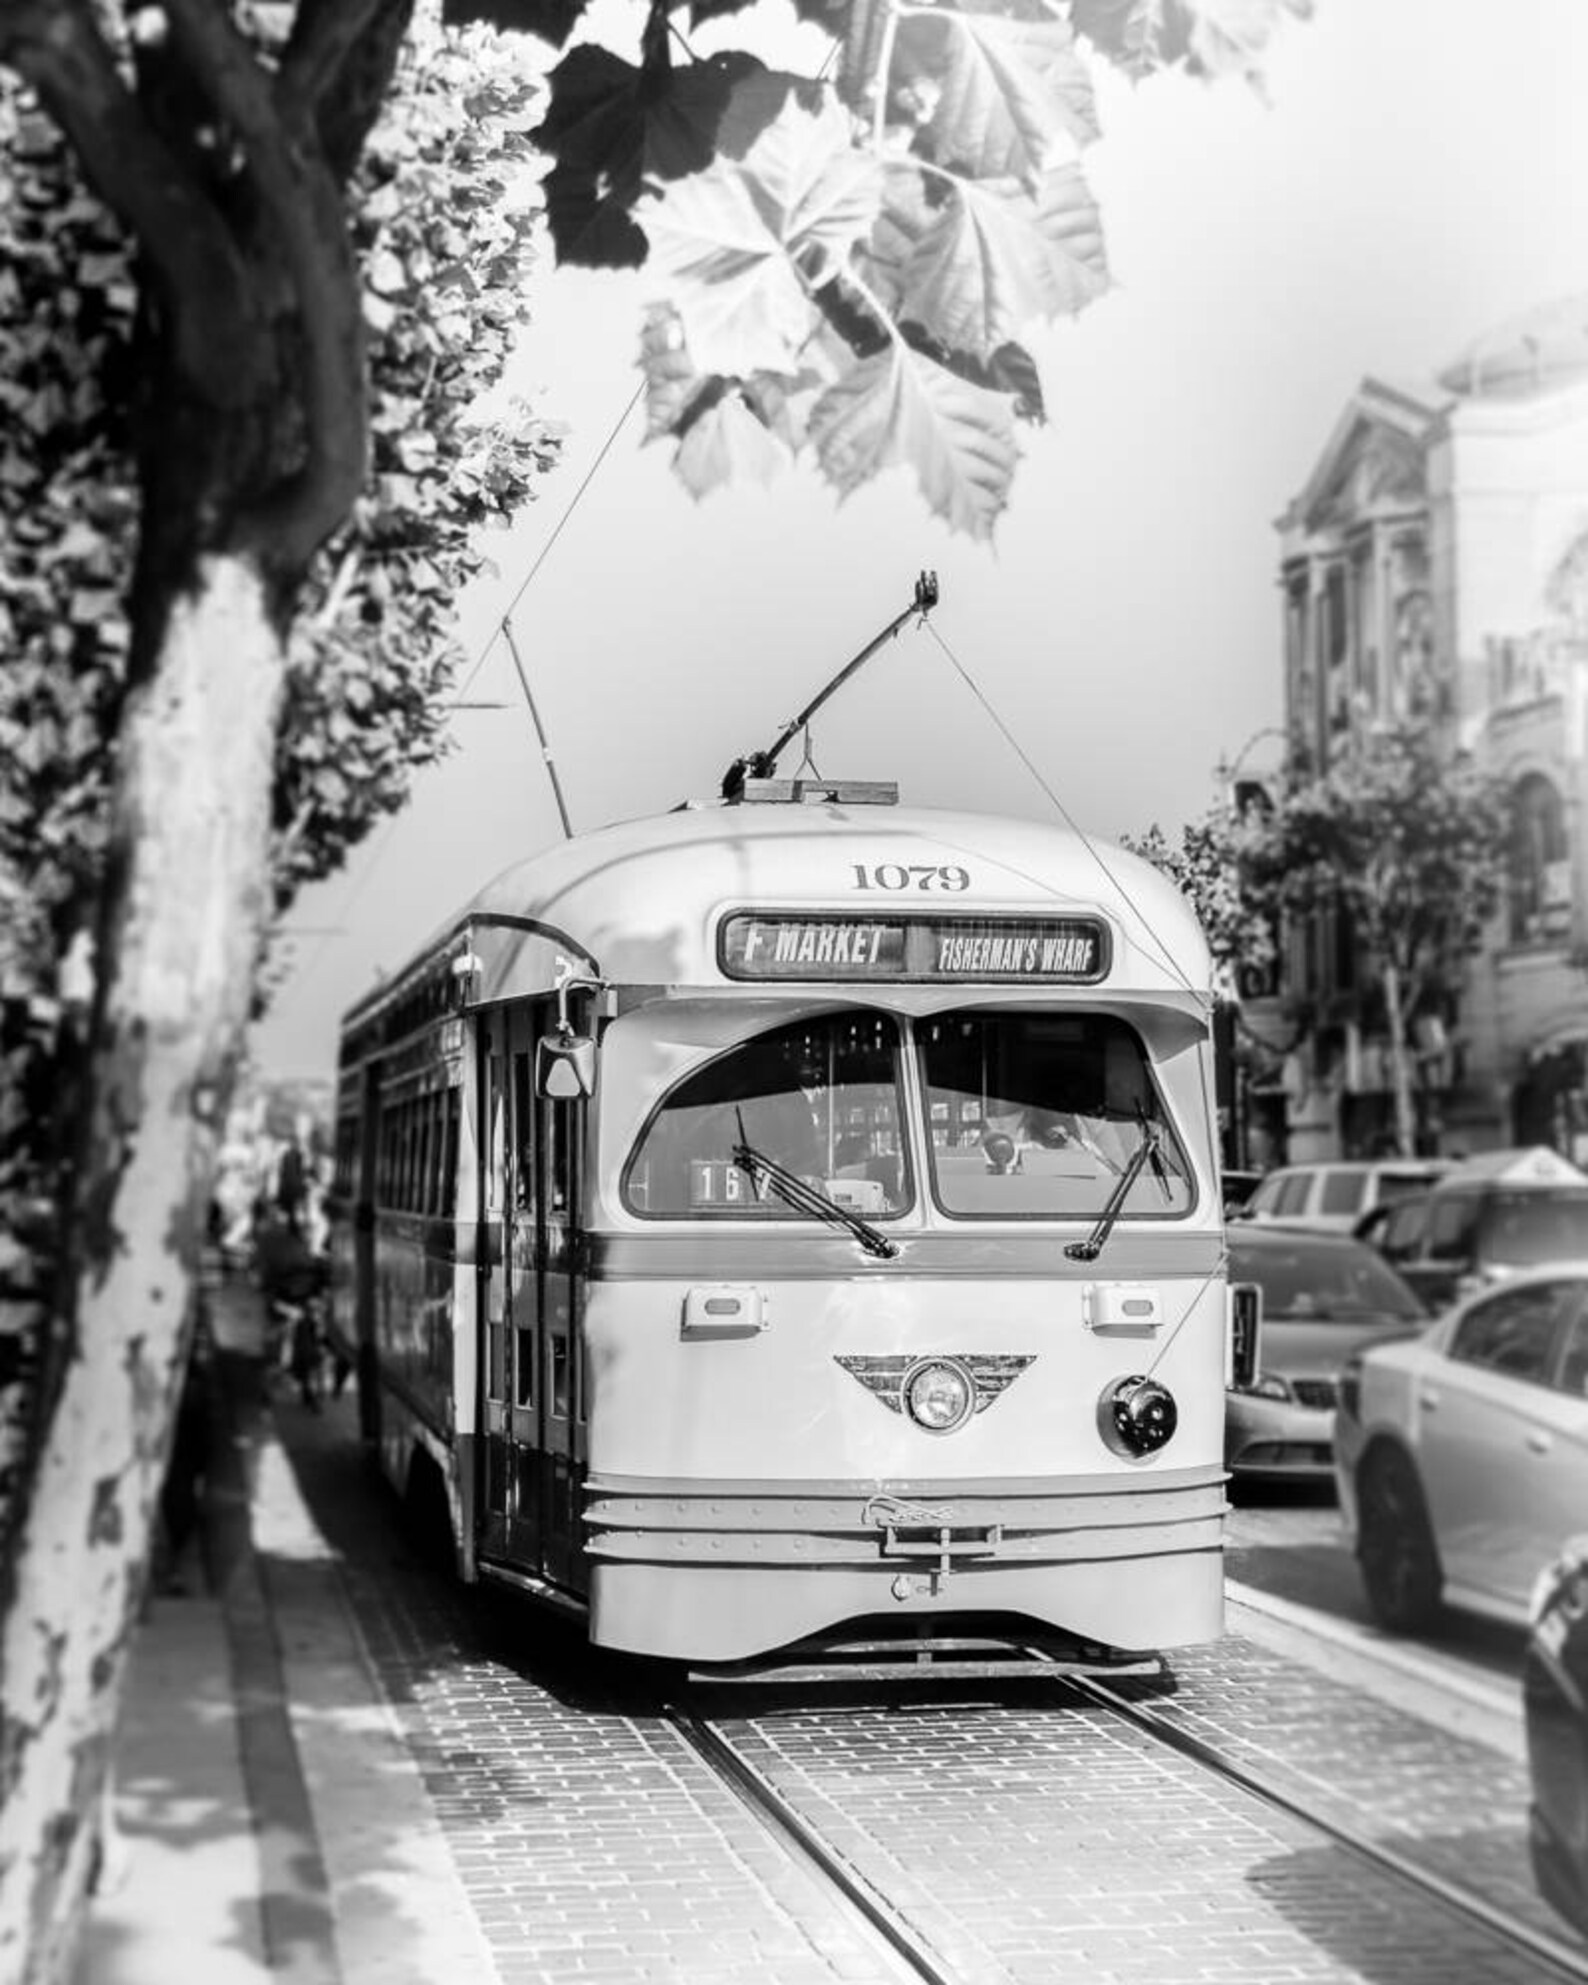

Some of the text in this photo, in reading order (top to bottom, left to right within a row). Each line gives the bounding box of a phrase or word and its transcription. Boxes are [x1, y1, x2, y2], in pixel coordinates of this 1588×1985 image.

[850, 865, 970, 891] 1079
[744, 923, 886, 963] F MARKET
[938, 938, 1093, 971] FISHERMAN'S WHARF
